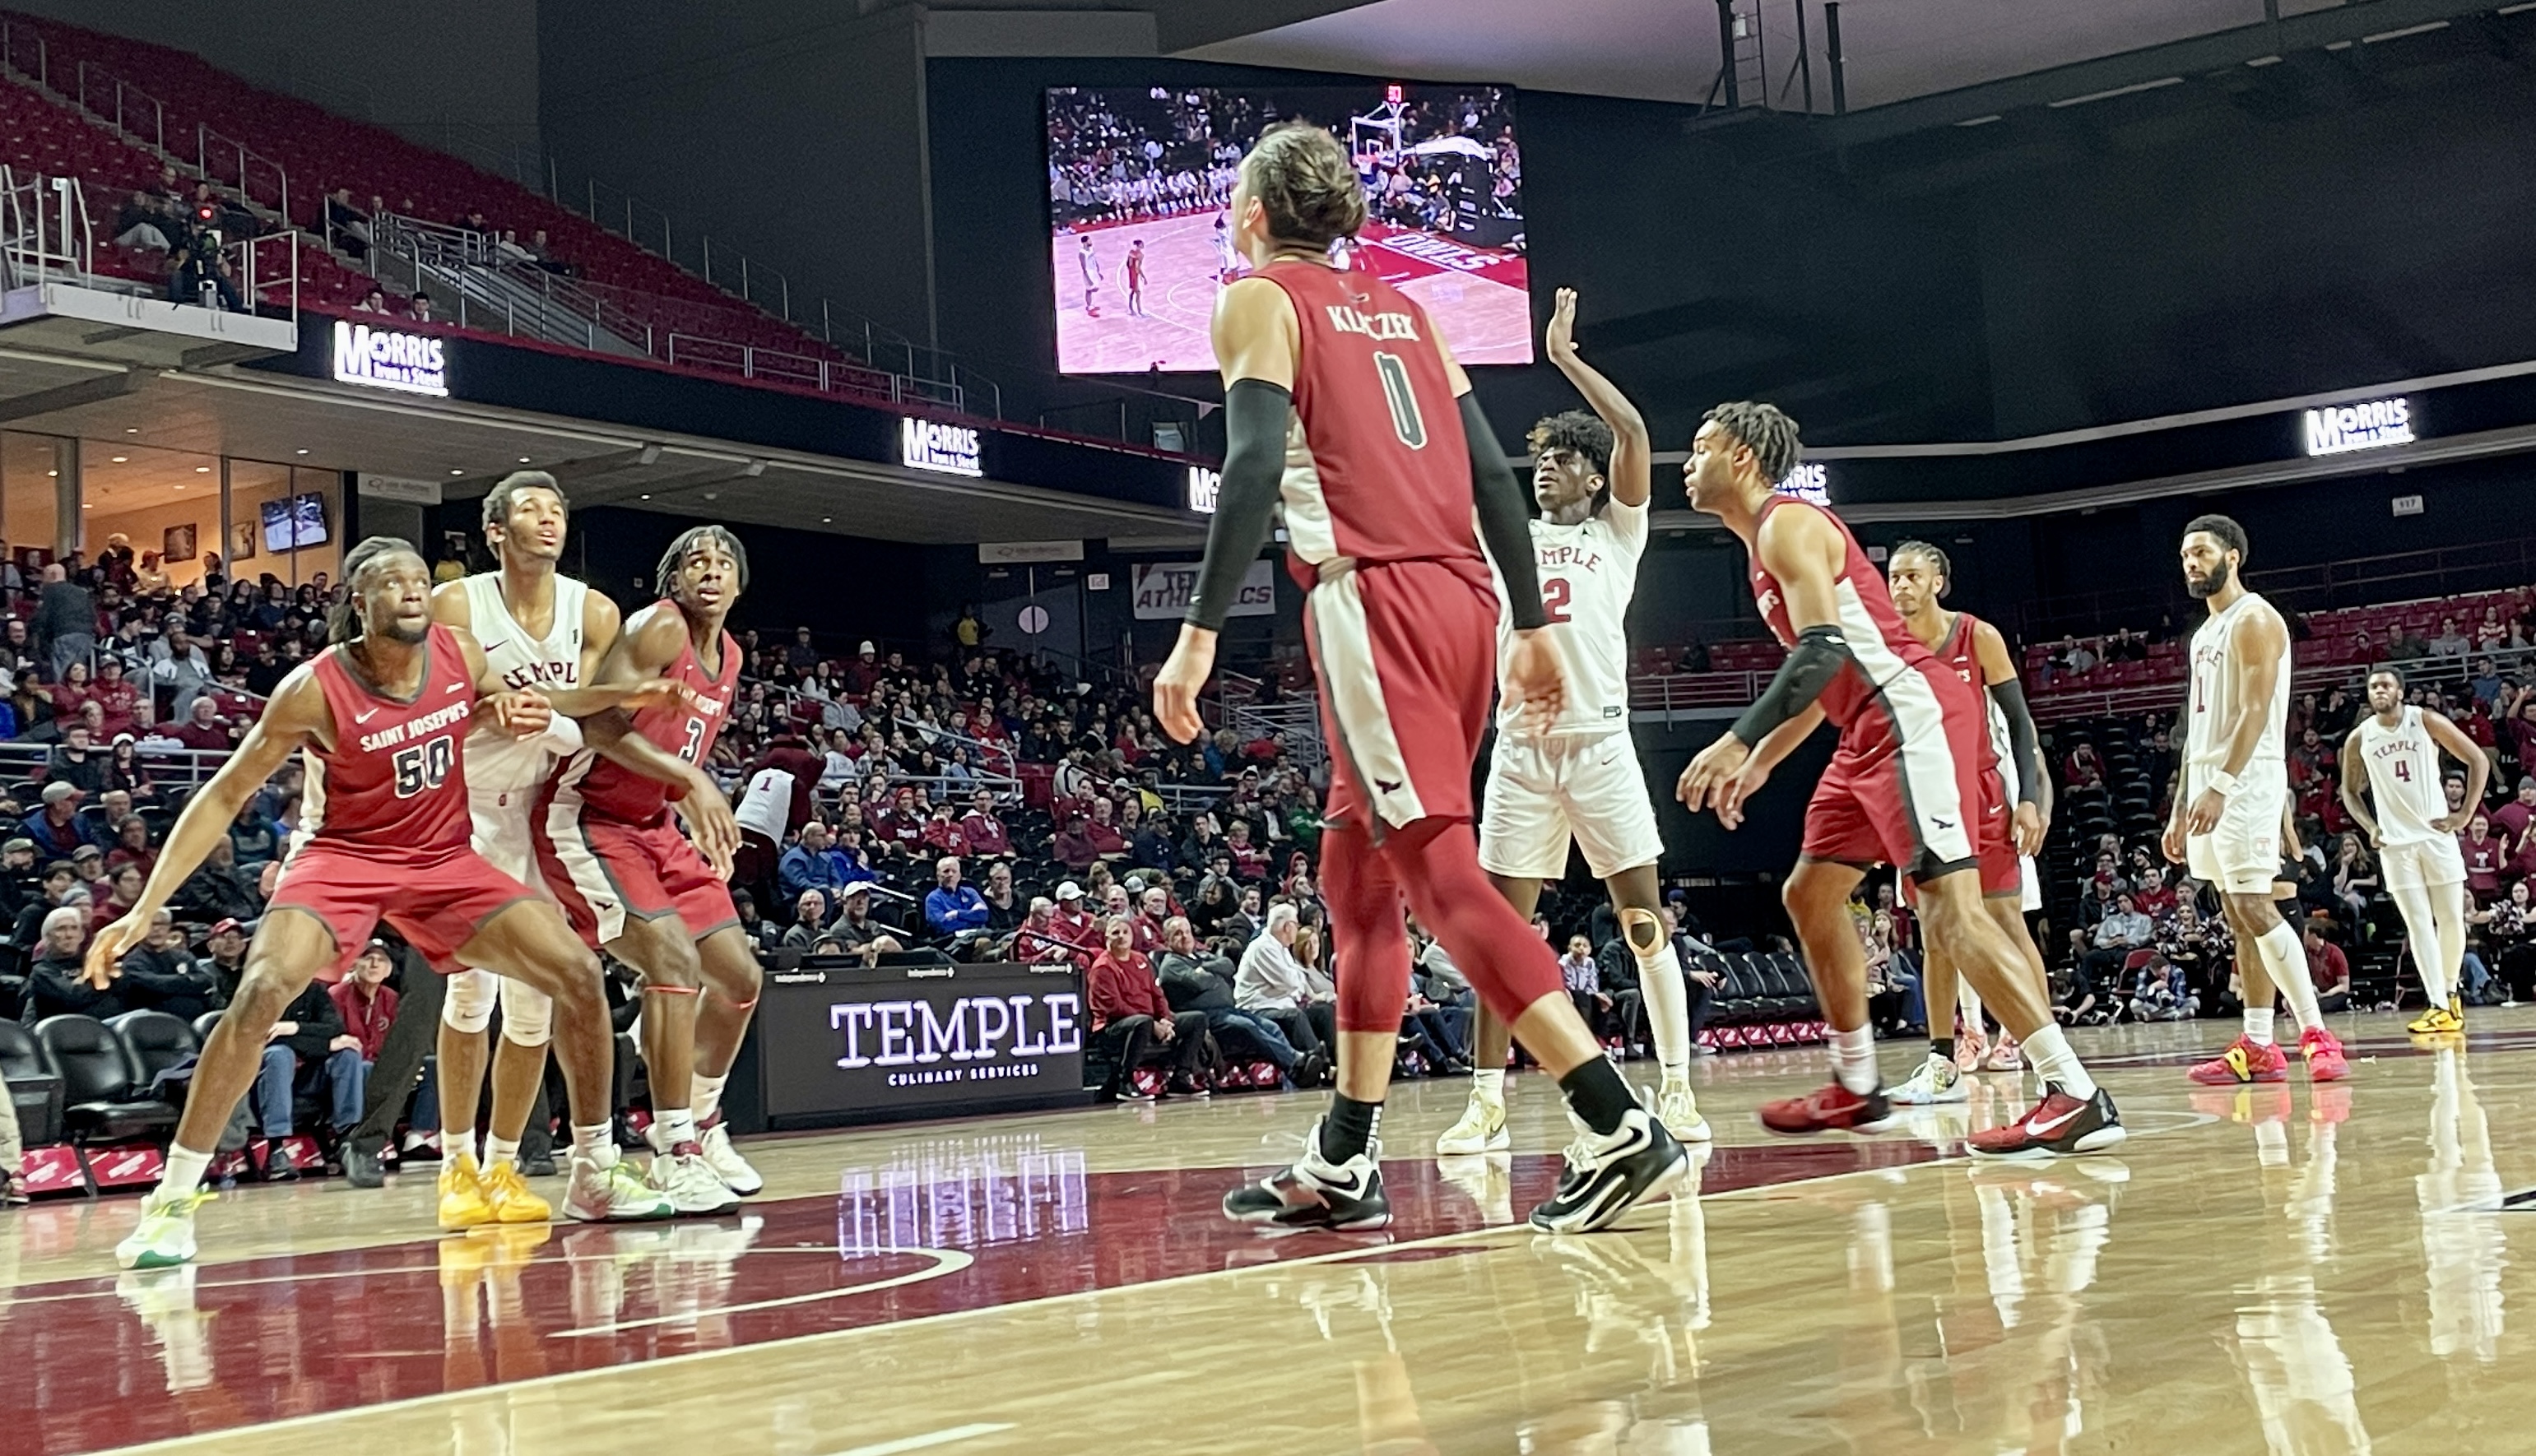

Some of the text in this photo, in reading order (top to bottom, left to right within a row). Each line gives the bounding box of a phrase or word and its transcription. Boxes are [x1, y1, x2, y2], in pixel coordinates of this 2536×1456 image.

[334, 321, 445, 378] MORRIS
[2306, 398, 2408, 450] MORRIS
[903, 417, 979, 464] MORRIS
[1540, 546, 1602, 574] MPLE
[1544, 577, 1572, 623] 2
[502, 661, 577, 690] TEMPL
[360, 724, 406, 753] SAINT
[2372, 740, 2420, 759] TEMPLE
[391, 734, 455, 799] 50
[2394, 759, 2412, 782] 4
[759, 777, 773, 792] 1
[830, 994, 1081, 1068] TEMPLE
[888, 1064, 1038, 1086] CULINARY SERVICES
